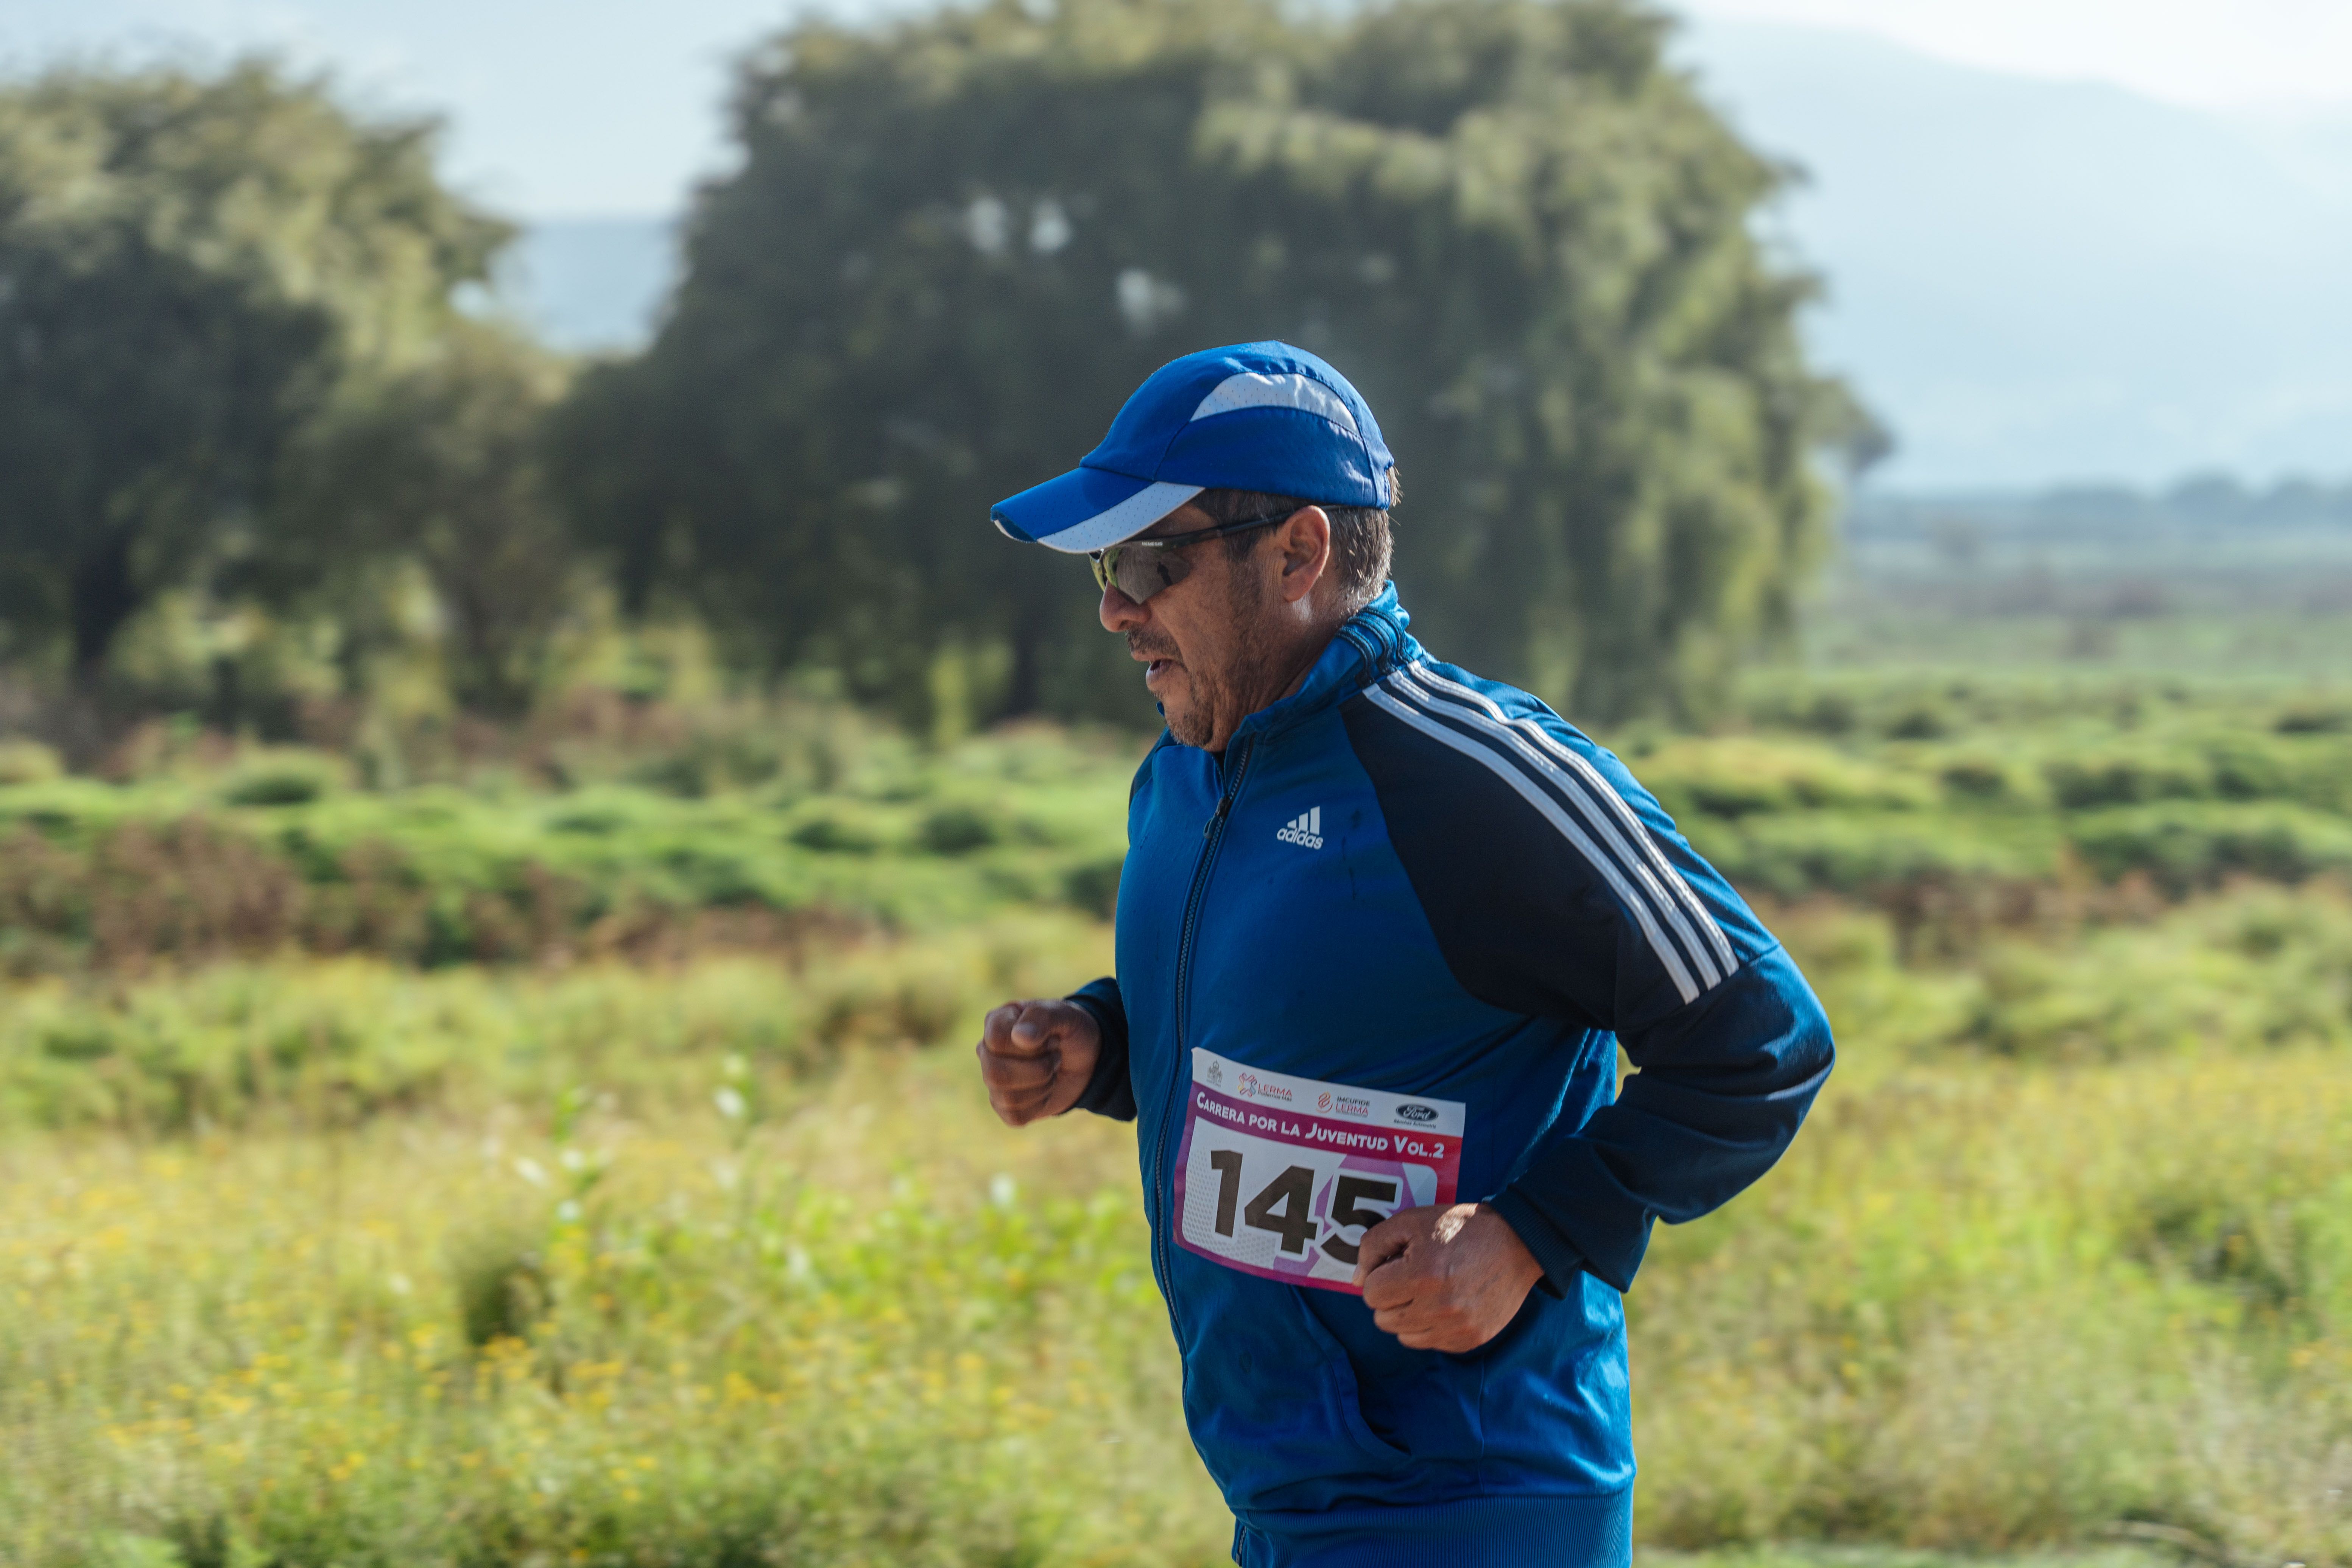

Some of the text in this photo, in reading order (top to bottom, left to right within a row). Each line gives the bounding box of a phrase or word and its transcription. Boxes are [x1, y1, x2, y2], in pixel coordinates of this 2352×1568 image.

[1277, 827, 1323, 850] adidas
[1258, 1083, 1292, 1097] LERMA
[1337, 1096, 1370, 1106] IMCUFIDE
[1336, 1103, 1368, 1115] LERMA
[1403, 1105, 1431, 1121] Ford
[1211, 1150, 1397, 1265] 145
